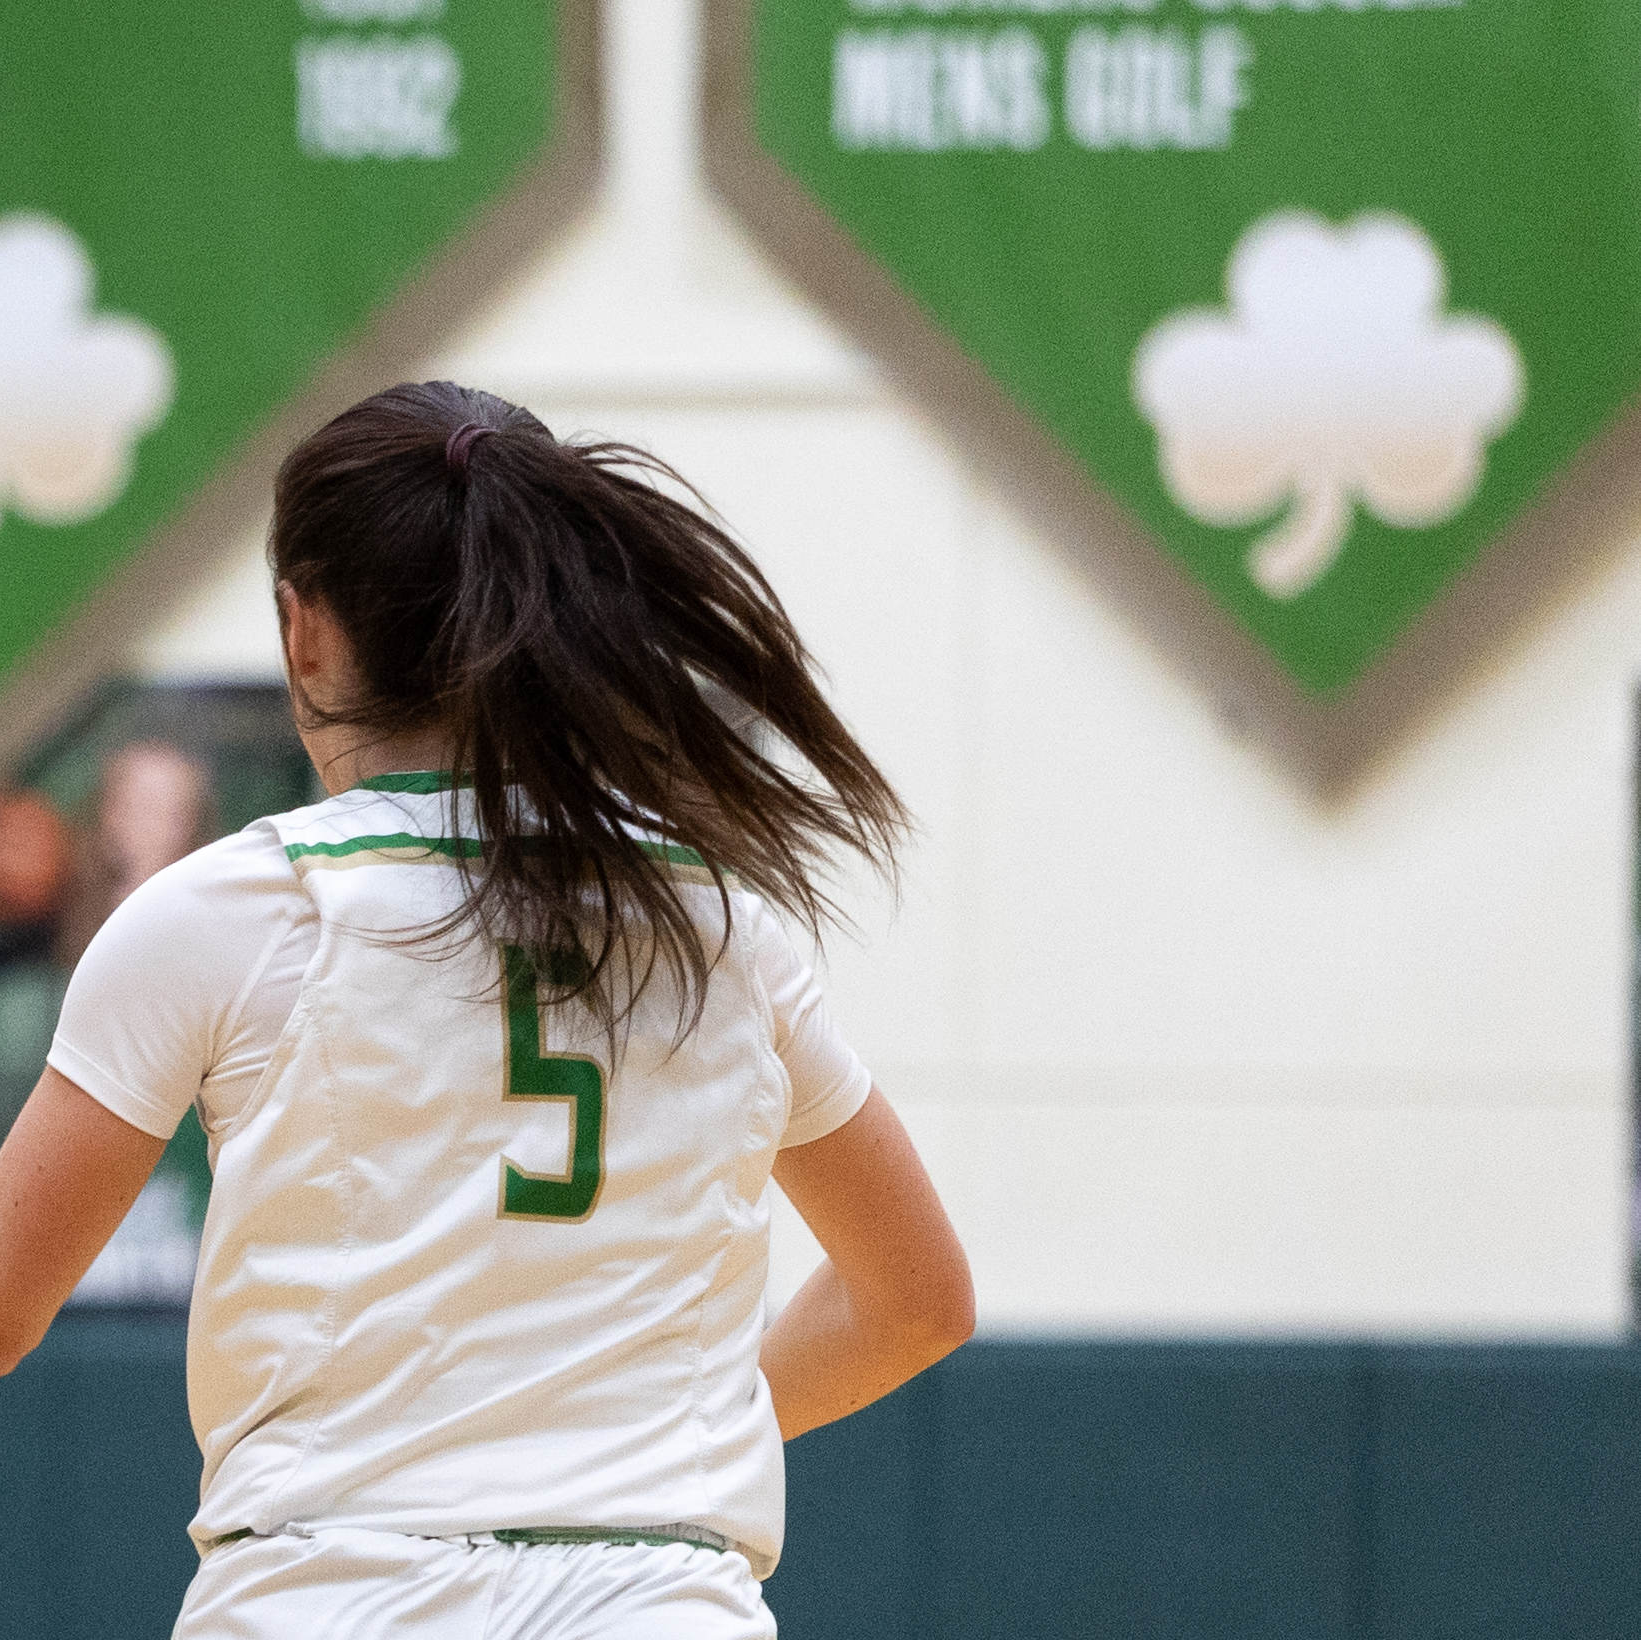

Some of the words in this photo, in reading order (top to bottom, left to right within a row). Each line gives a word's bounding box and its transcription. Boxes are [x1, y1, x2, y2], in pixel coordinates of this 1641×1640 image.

[836, 27, 1047, 150] MENS
[1065, 24, 1255, 150] GOLF
[497, 938, 608, 1225] 5
